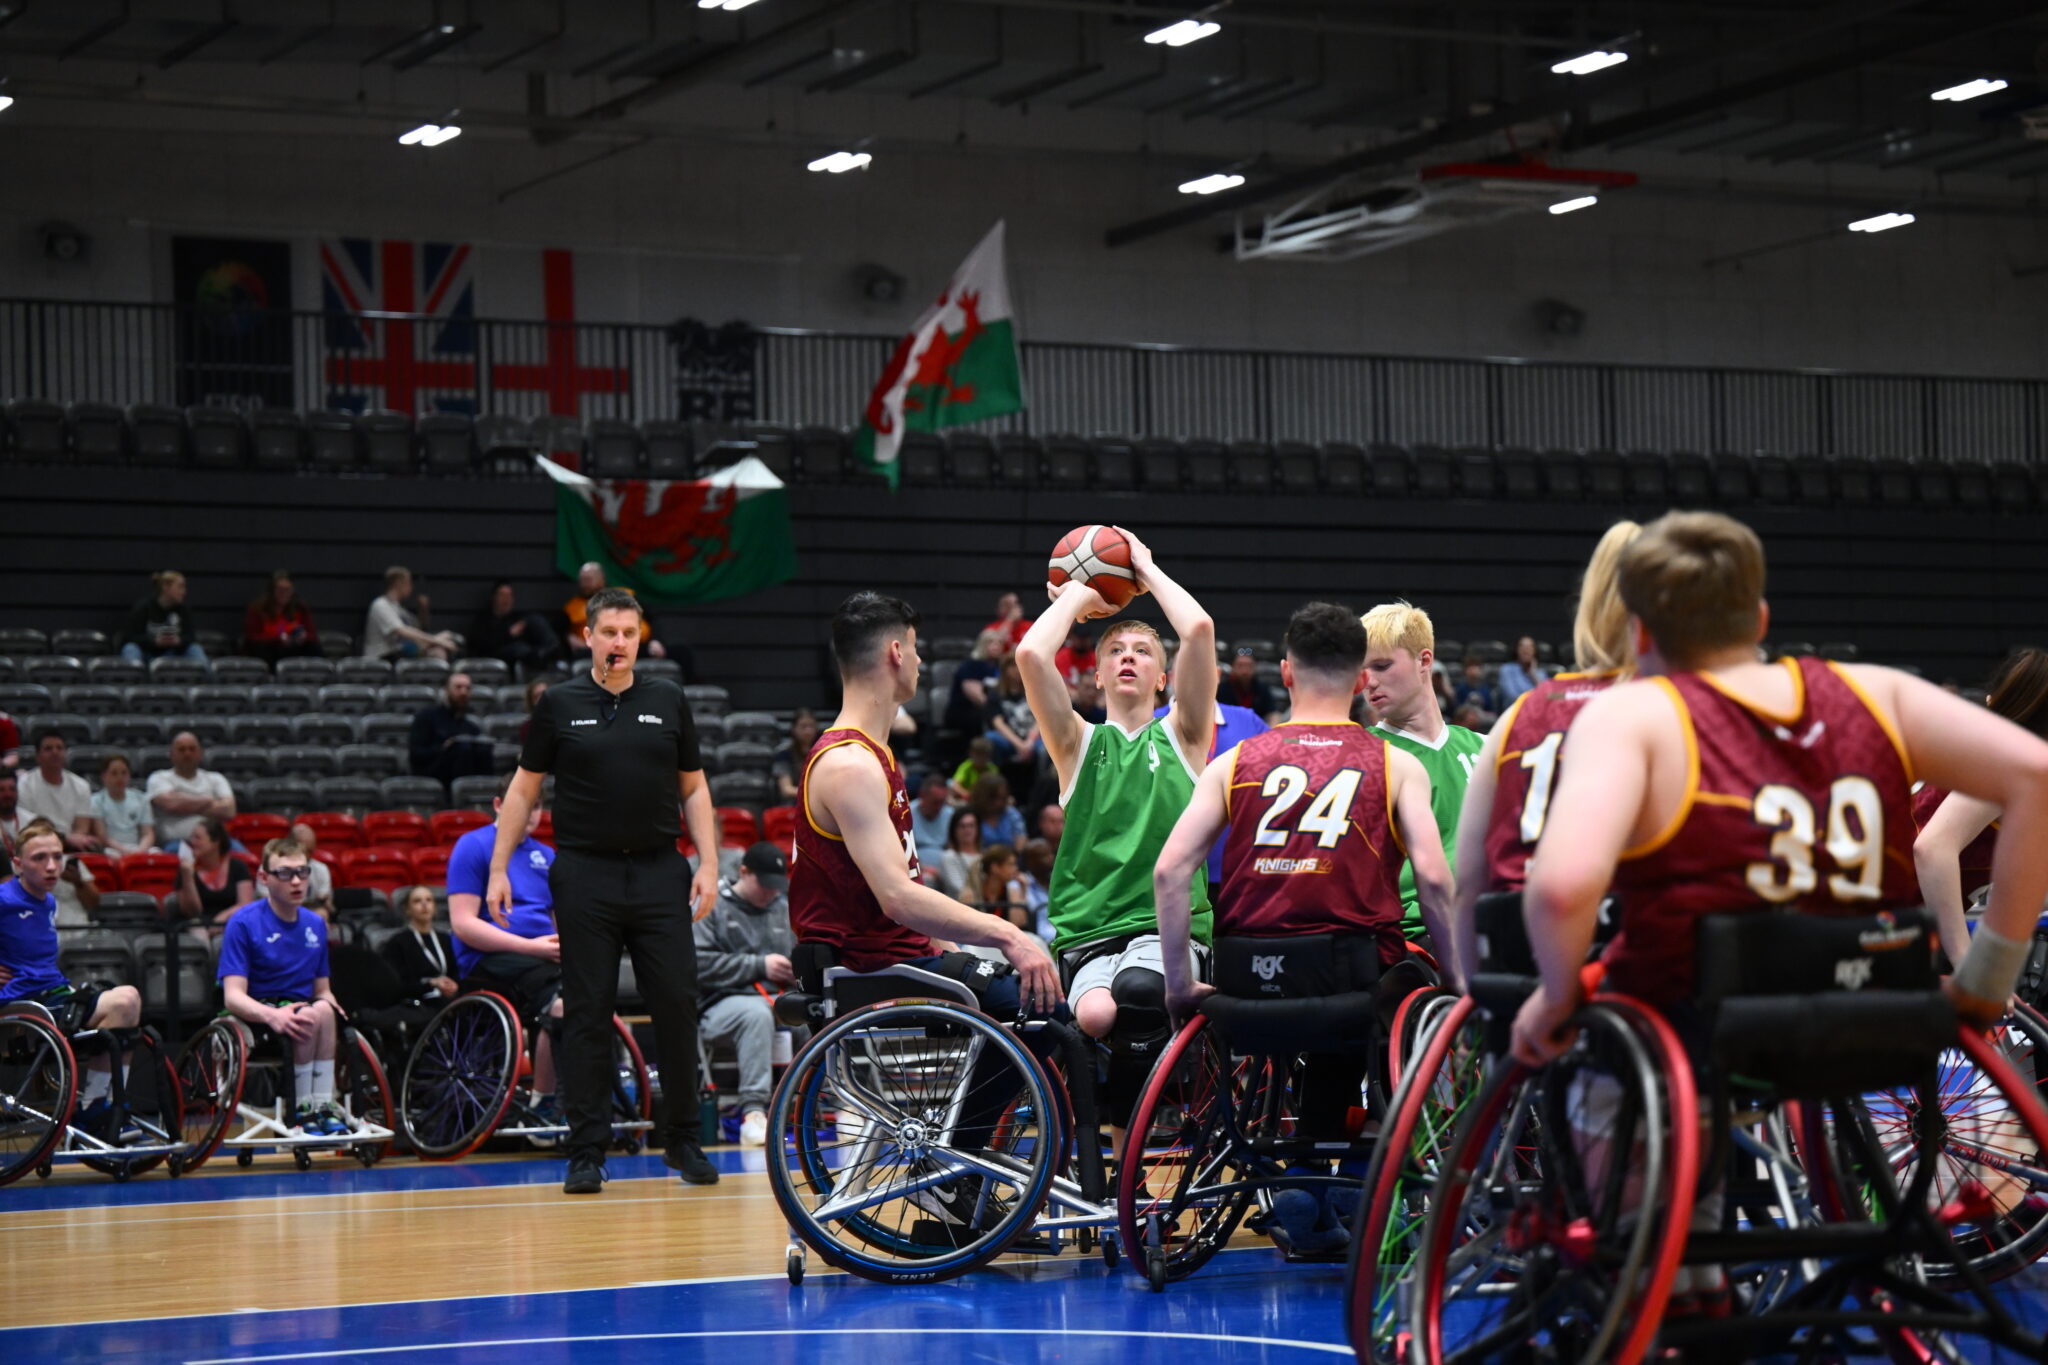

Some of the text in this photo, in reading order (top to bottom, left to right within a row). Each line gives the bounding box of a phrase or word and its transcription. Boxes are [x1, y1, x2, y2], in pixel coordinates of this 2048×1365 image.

[1252, 764, 1363, 849] 24
[1746, 776, 1884, 901] 39
[1253, 858, 1319, 873] KNIGHTS
[891, 1272, 936, 1280] KENDA
